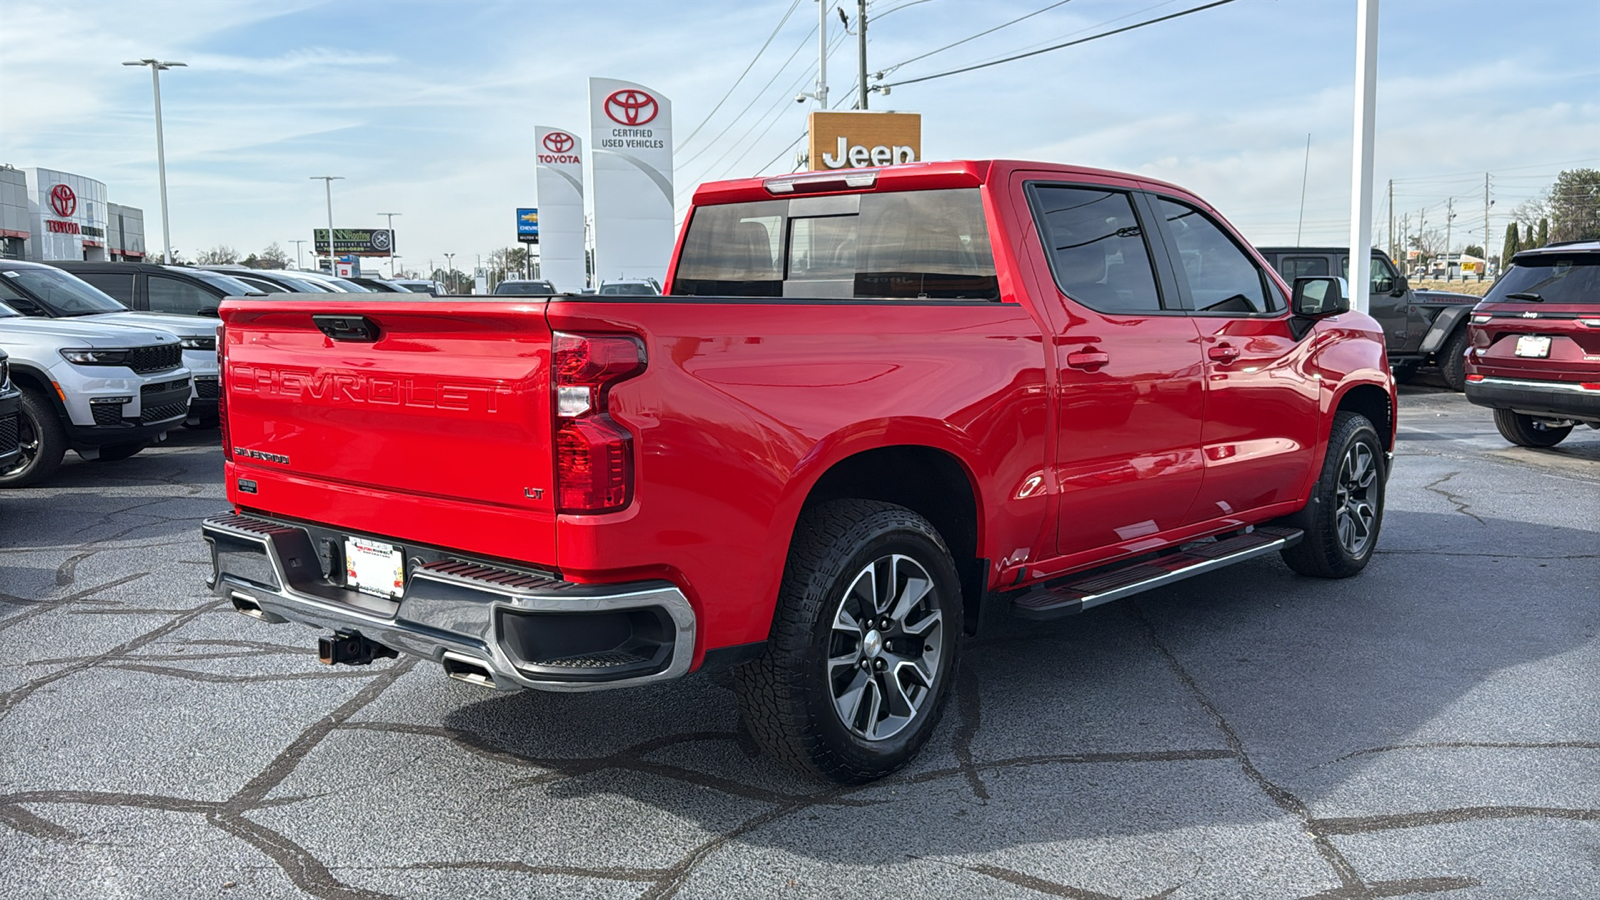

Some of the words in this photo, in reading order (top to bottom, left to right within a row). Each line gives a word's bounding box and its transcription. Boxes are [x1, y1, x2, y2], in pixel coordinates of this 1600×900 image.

[612, 129, 653, 138] CERTIFIED
[602, 139, 624, 148] USED
[626, 140, 664, 149] VEHICLES
[822, 136, 915, 168] Jeep
[538, 155, 580, 164] TOYOTA
[48, 220, 80, 234] TOYOTA
[348, 231, 370, 241] Roofing
[1523, 311, 1538, 319] Jeep
[231, 366, 512, 413] CHEVROLET
[234, 446, 290, 464] SILVERADO
[524, 486, 544, 499] LT
